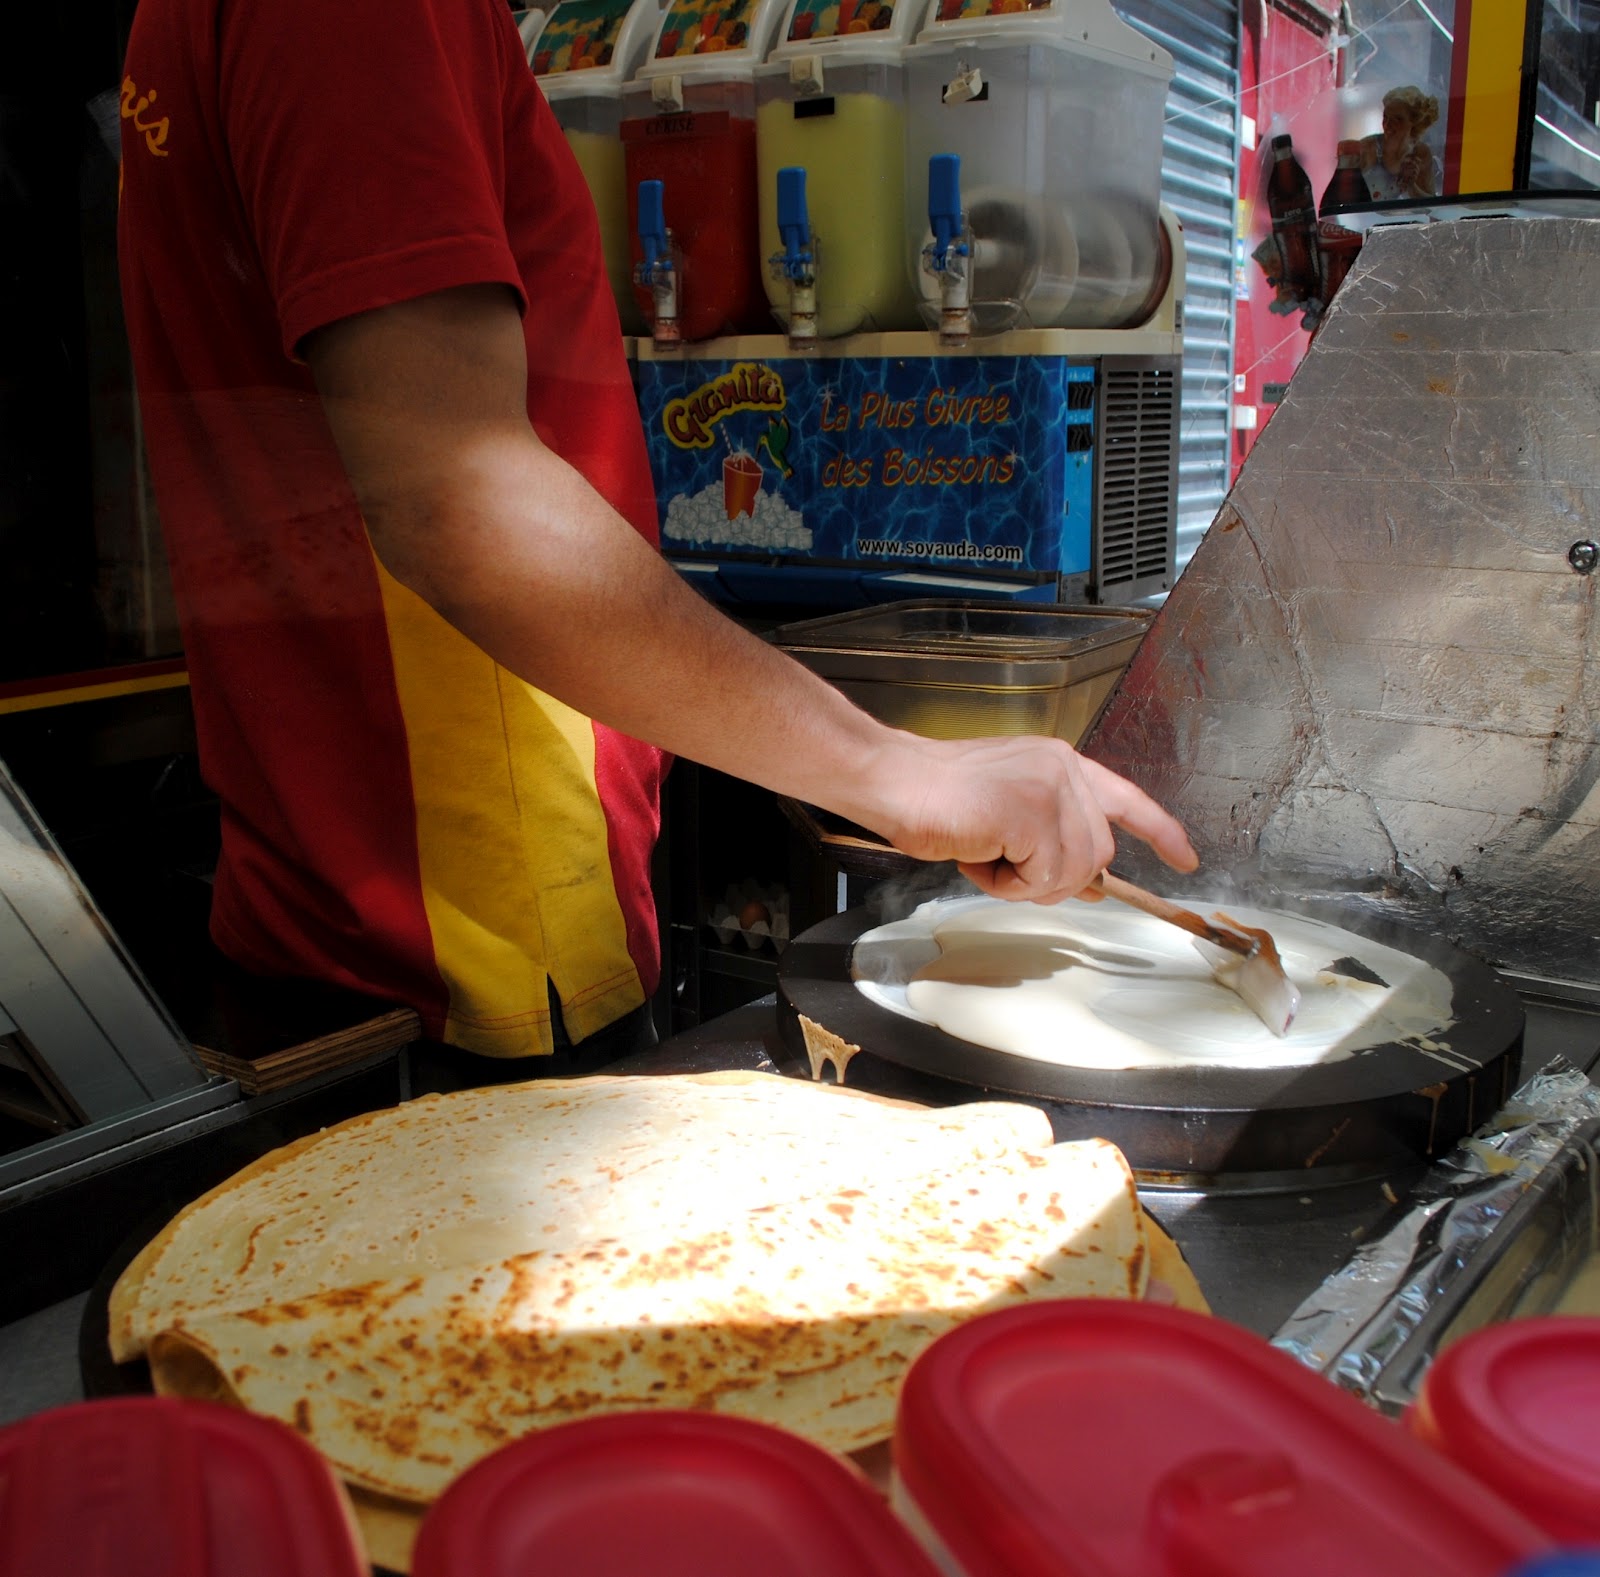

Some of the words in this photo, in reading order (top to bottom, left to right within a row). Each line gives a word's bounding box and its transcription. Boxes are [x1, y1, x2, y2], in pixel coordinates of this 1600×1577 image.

[645, 117, 695, 135] CERISE
[820, 396, 849, 431] La
[858, 391, 917, 430] Plus
[924, 384, 1010, 427] Givrée
[822, 450, 872, 487] des
[882, 445, 1014, 486] Boissons
[857, 539, 1023, 563] www.sovauda.com
